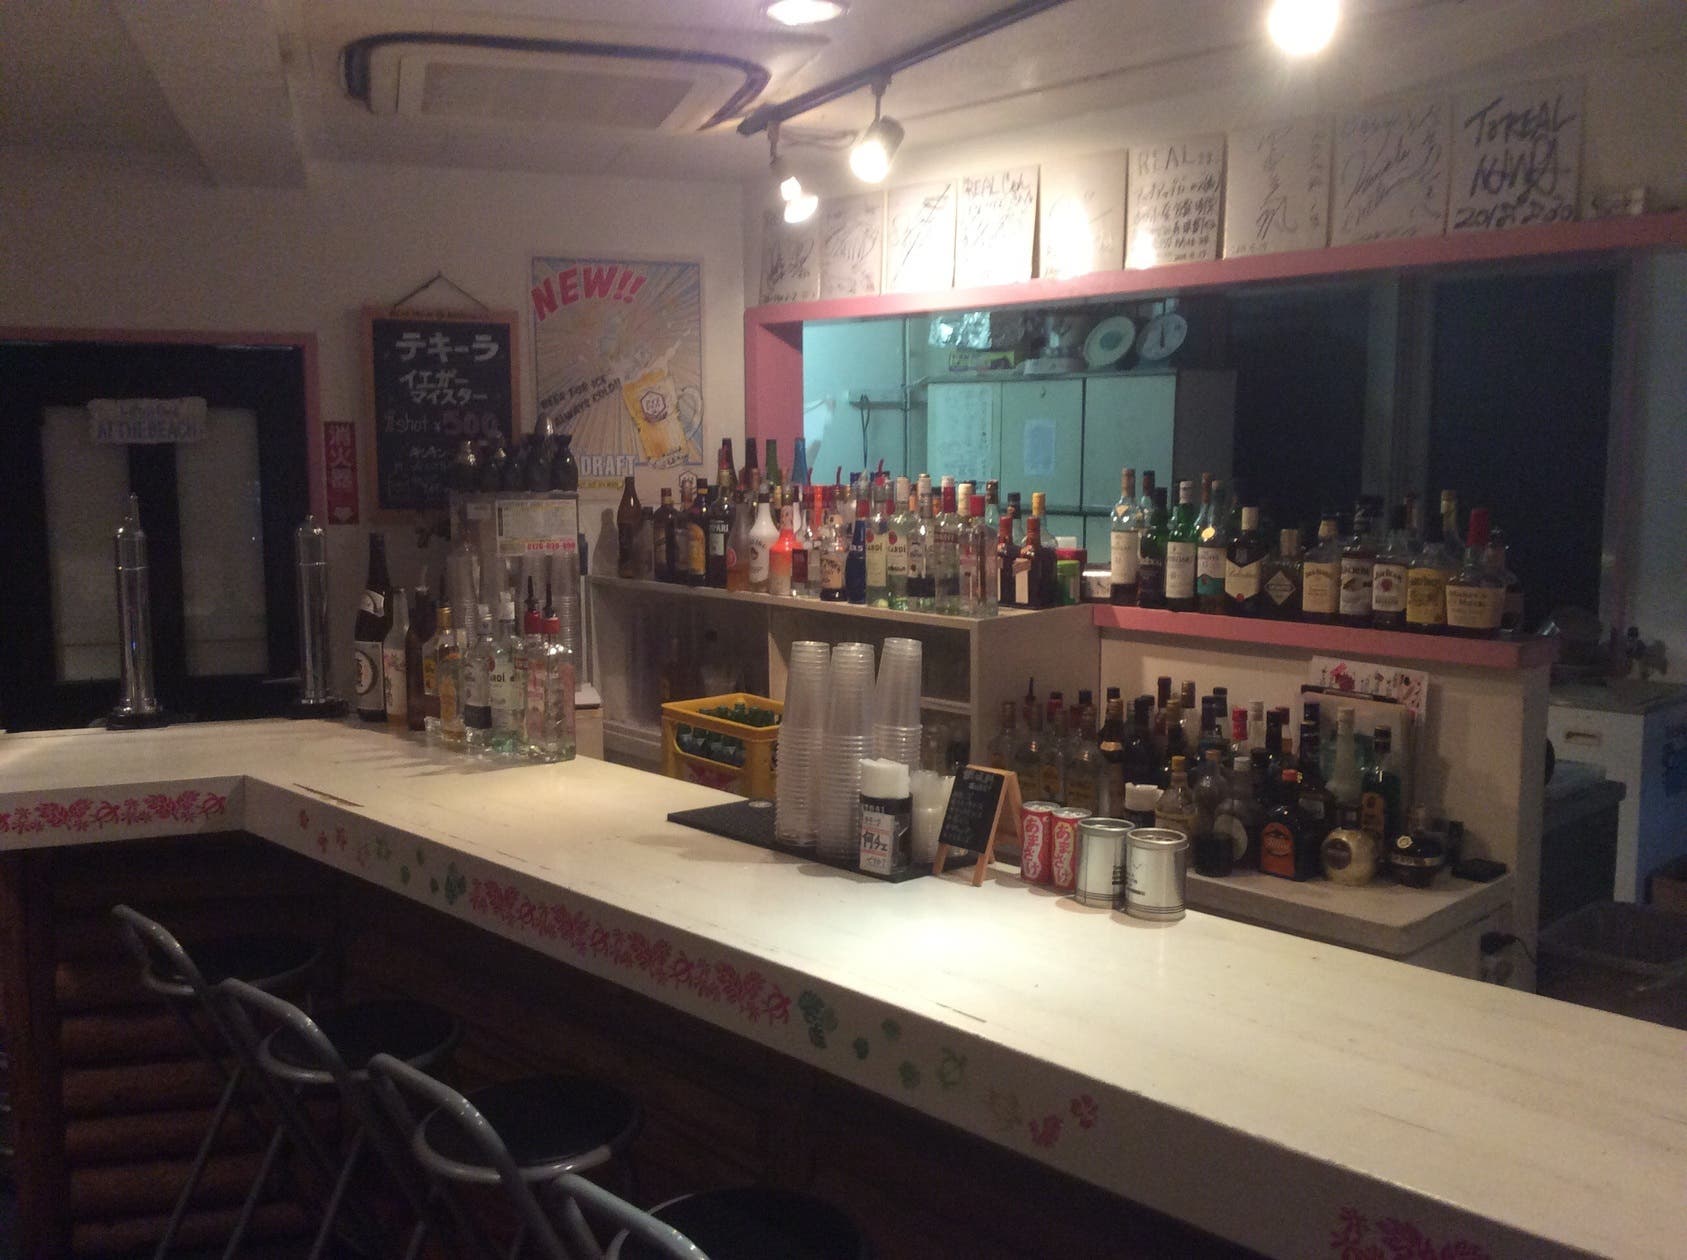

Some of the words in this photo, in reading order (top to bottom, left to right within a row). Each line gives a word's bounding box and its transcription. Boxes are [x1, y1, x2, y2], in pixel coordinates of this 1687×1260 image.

[530, 264, 647, 321] NEW!!
[395, 331, 499, 363] テキーラ
[410, 387, 488, 405] マイスター
[327, 424, 354, 489] 消火器
[579, 454, 636, 477] DRAFT
